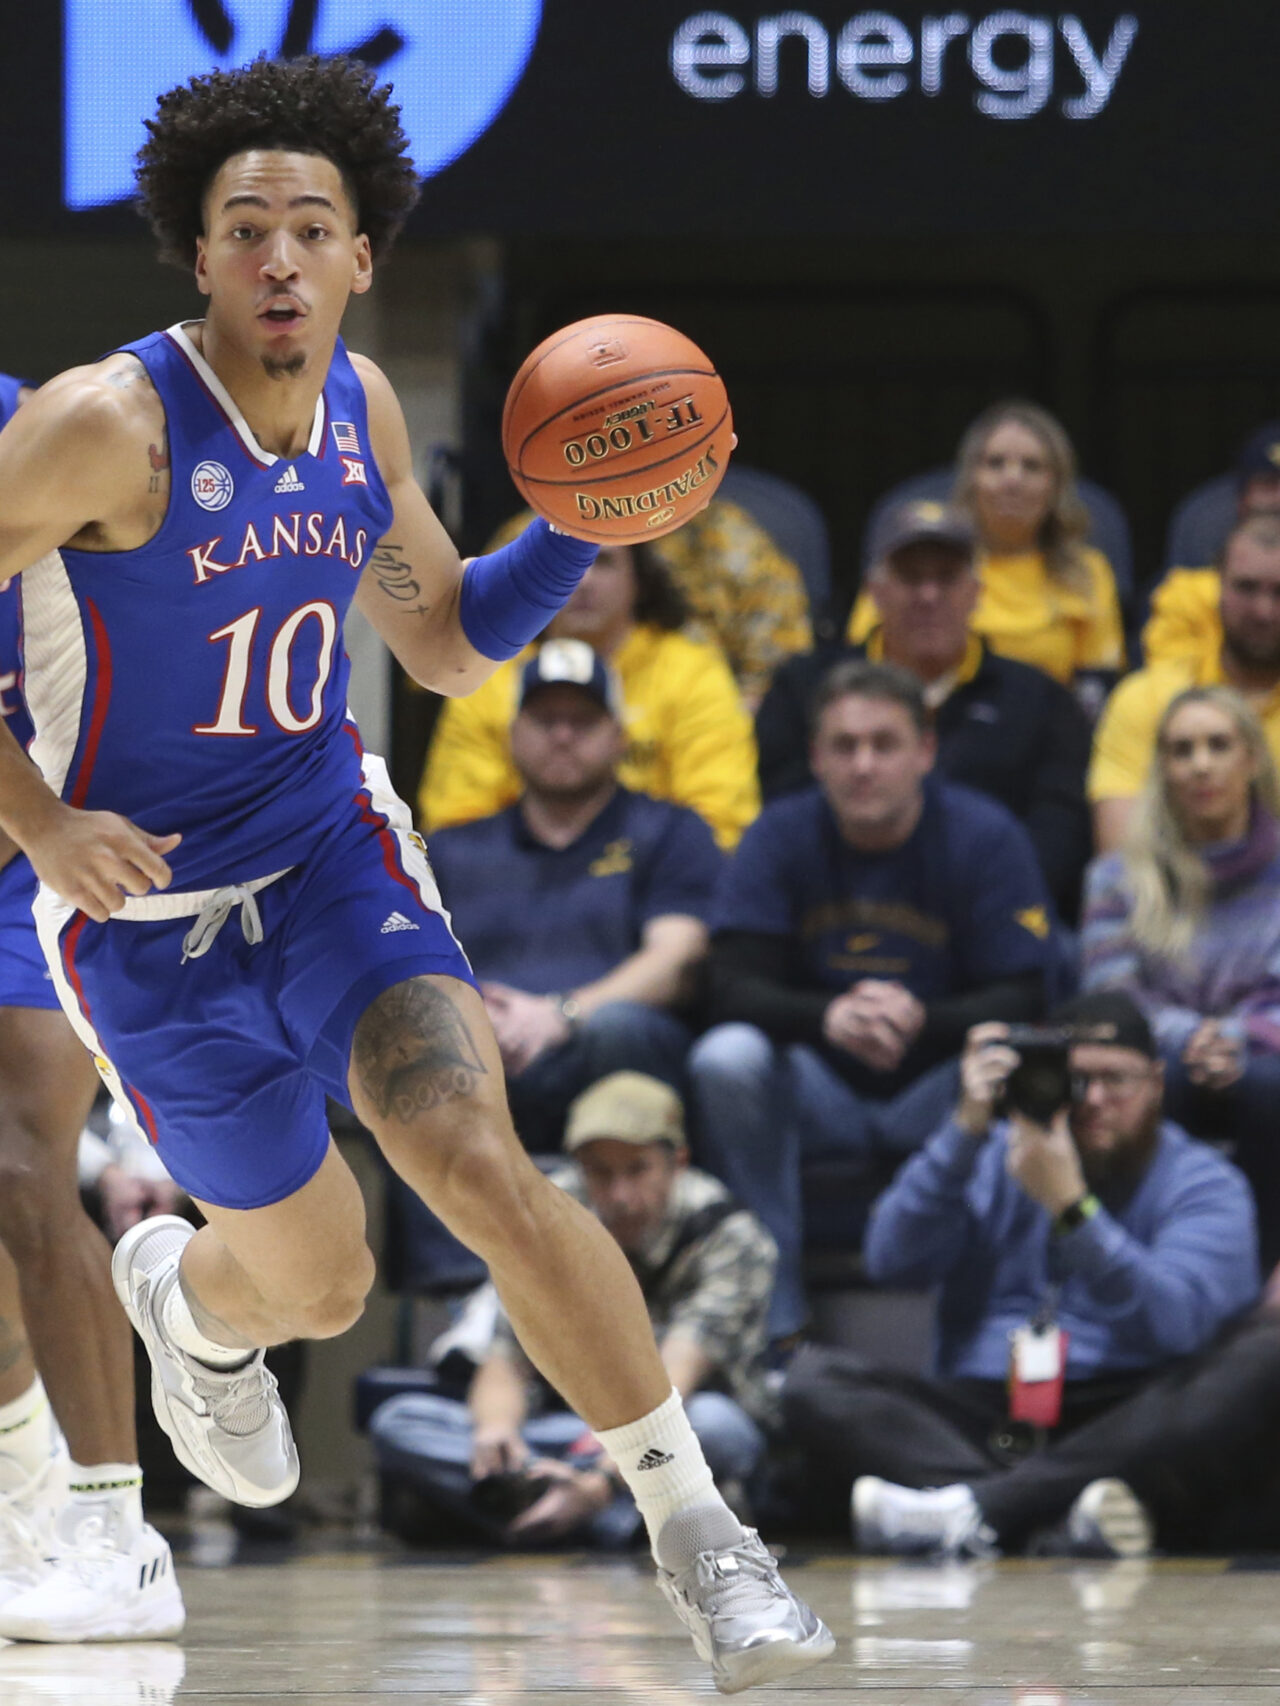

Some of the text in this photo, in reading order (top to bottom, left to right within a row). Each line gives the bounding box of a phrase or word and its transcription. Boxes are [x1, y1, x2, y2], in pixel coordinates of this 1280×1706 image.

[670, 10, 1139, 119] energy
[564, 399, 704, 466] TF-1000
[197, 478, 216, 493] 125
[274, 482, 305, 494] adidas
[576, 443, 719, 521] SPALDING
[186, 511, 368, 585] KANSAS
[191, 598, 338, 737] 10
[380, 923, 419, 934] adidas
[637, 1453, 675, 1471] adidas
